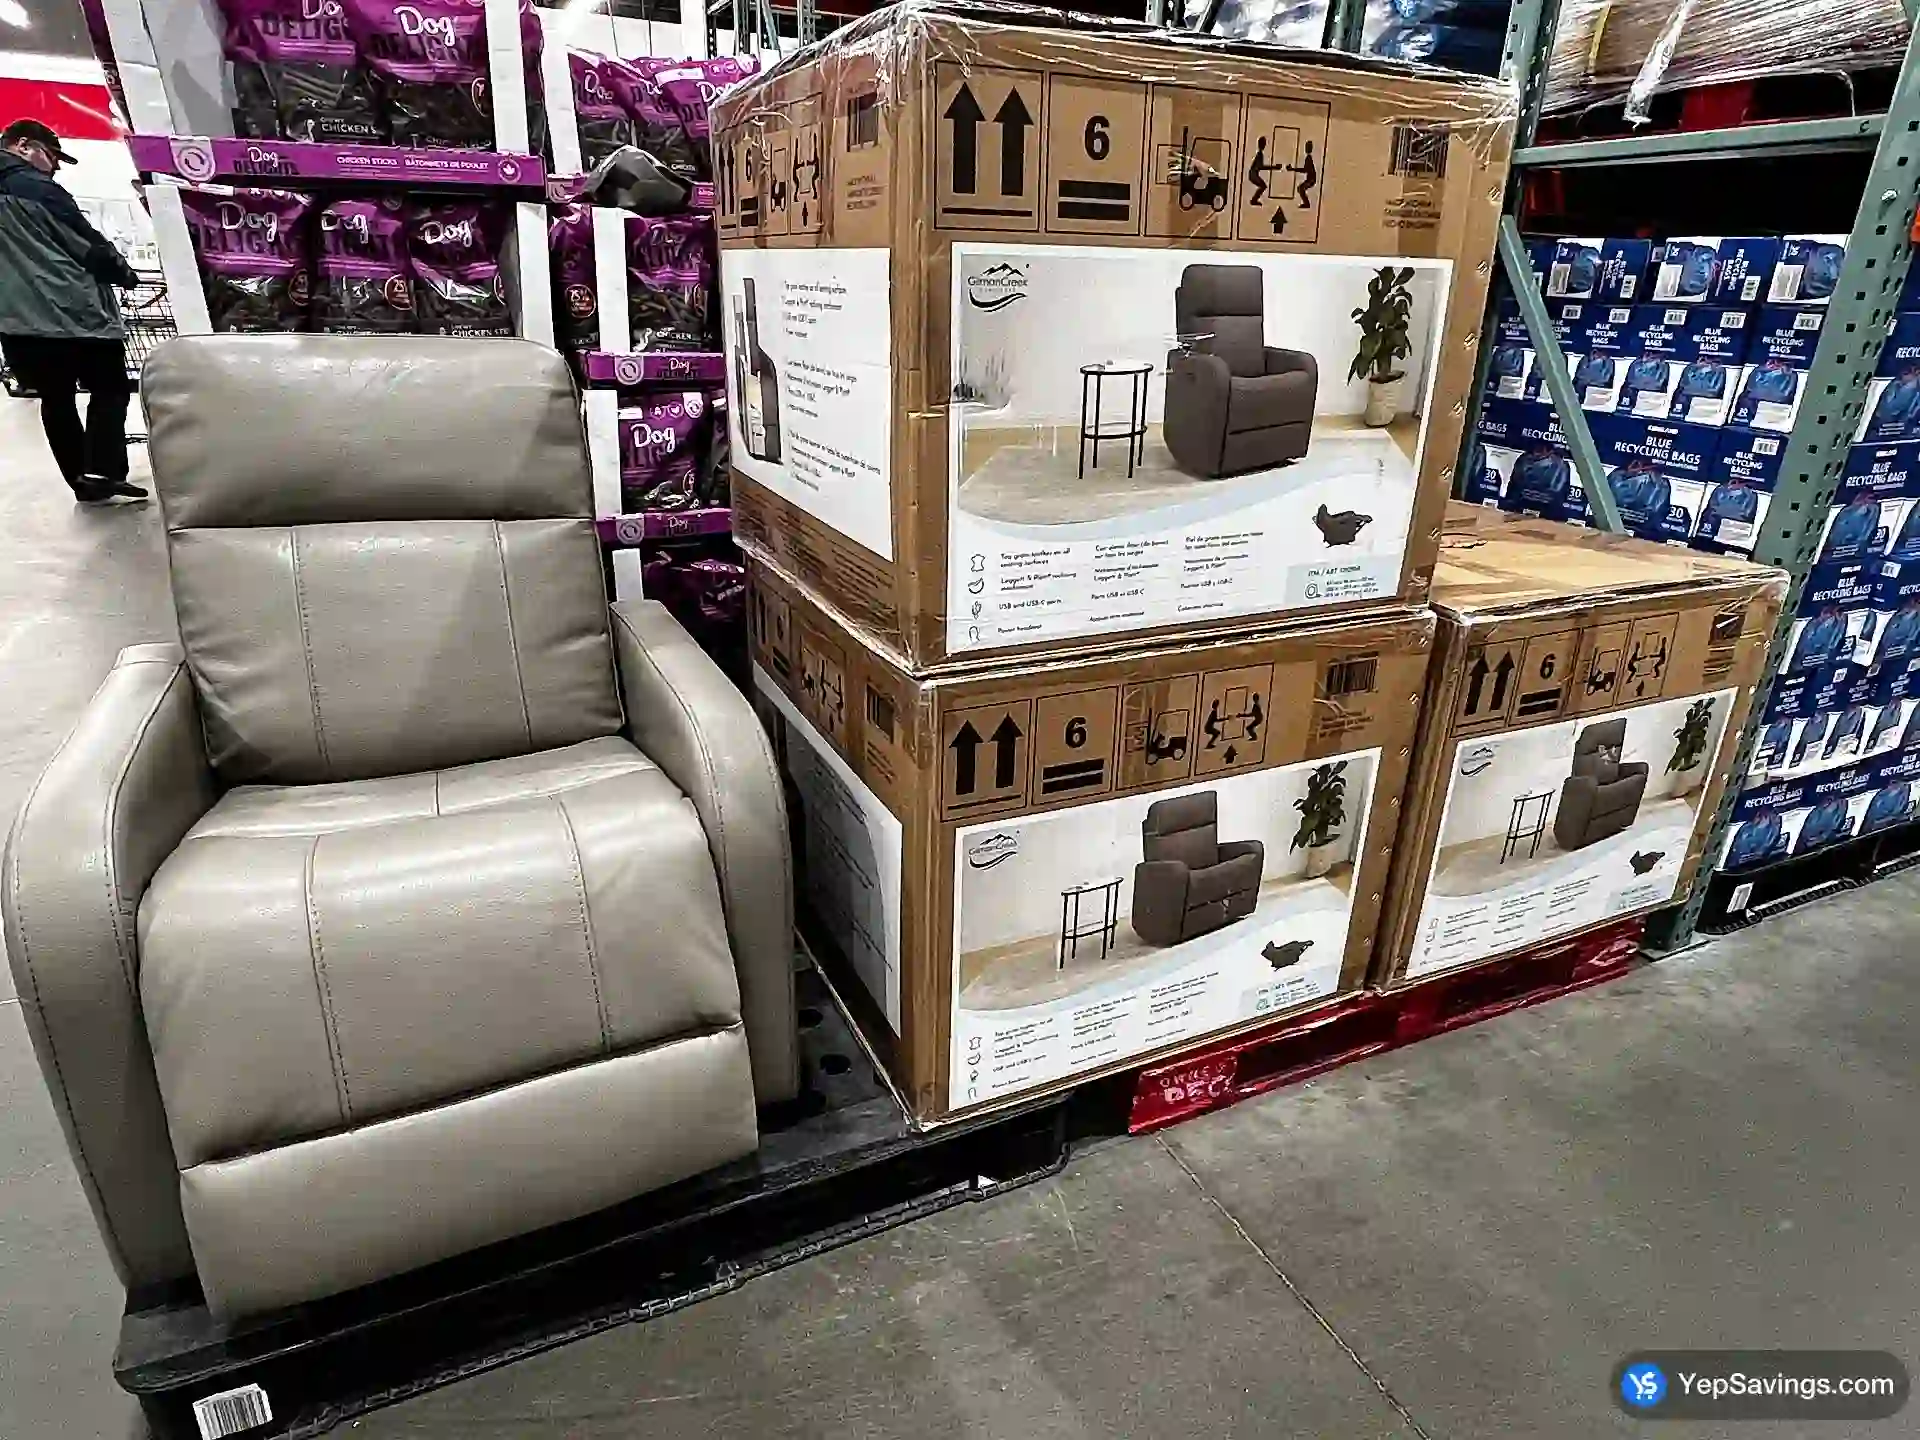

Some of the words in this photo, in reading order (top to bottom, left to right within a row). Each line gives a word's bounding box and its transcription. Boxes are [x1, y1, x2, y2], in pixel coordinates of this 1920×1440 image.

[393, 5, 457, 47] Dog
[322, 123, 370, 135] CHICKEN
[1083, 115, 1110, 161] 6
[247, 147, 278, 168] Dog
[216, 201, 279, 242] Dog
[420, 219, 474, 248] Dog
[1704, 327, 1722, 335] BLUE
[1776, 329, 1796, 337] BLUE
[1692, 335, 1731, 344] RECYCLING
[1762, 336, 1805, 347] RECYCLING
[1700, 342, 1719, 351] BAGS
[1769, 345, 1791, 354] BAGS
[668, 357, 691, 373] Dog
[1486, 422, 1507, 433] BAGS
[630, 423, 676, 453] Dog
[1646, 436, 1673, 449] BLUE
[1614, 441, 1669, 460] RECYCLING
[1672, 452, 1701, 465] BAGS
[1735, 451, 1753, 460] BLUE
[1723, 457, 1763, 470] RECYCLING
[1872, 462, 1892, 473] BLUE
[1485, 469, 1496, 480] 30
[1731, 466, 1750, 476] BAGS
[1846, 474, 1886, 487] RECYCLING
[1569, 487, 1582, 498] 30
[1668, 506, 1684, 519] 30
[1539, 653, 1556, 680] 6
[1064, 716, 1087, 750] 6
